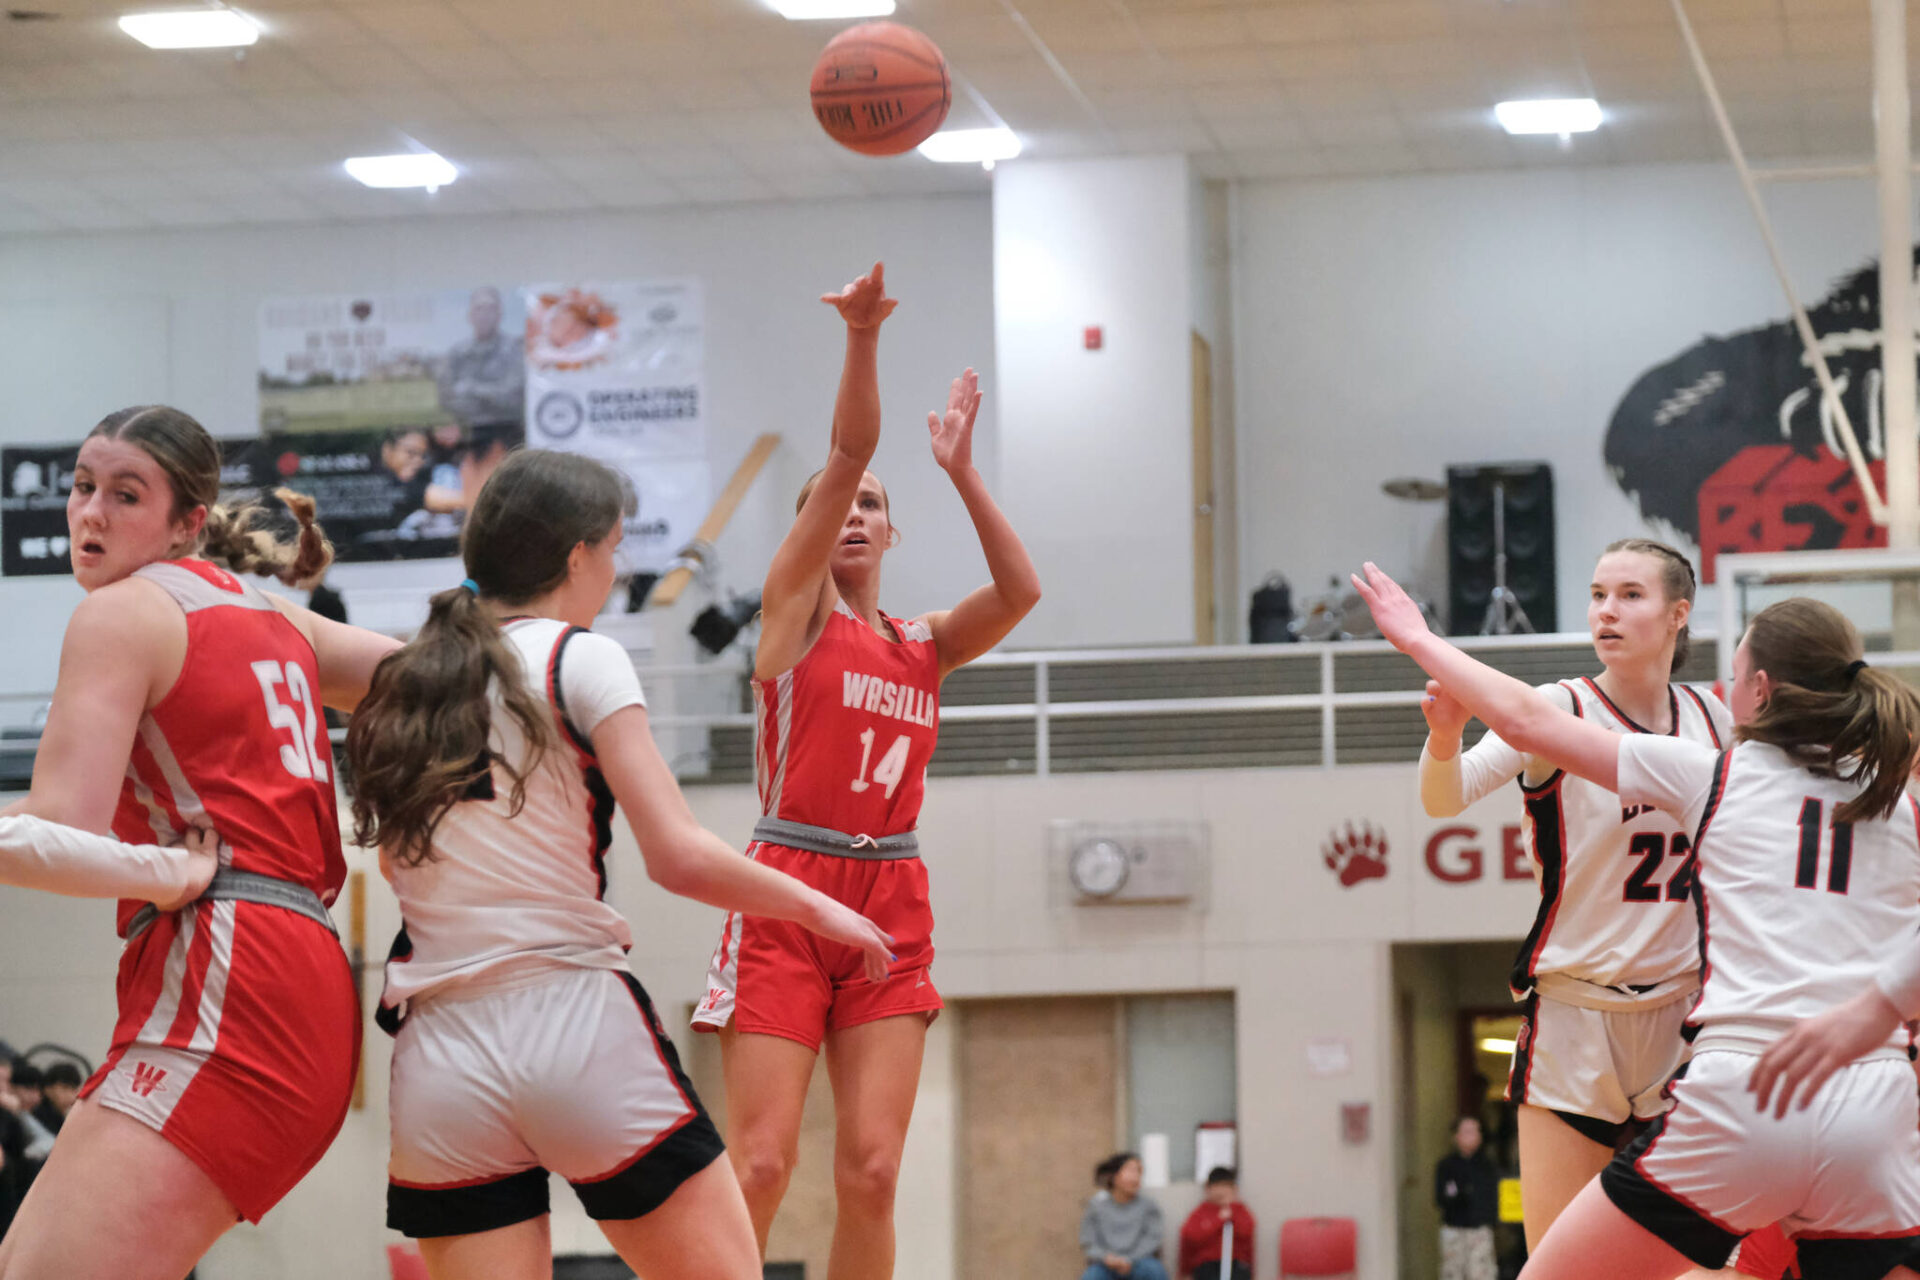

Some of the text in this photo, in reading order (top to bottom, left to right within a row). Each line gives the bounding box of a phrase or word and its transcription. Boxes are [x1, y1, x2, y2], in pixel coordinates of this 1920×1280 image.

[251, 660, 329, 783] 52
[842, 670, 935, 729] WASILLA
[850, 726, 911, 800] 14
[1622, 831, 1693, 902] 22
[1794, 796, 1854, 896] 11
